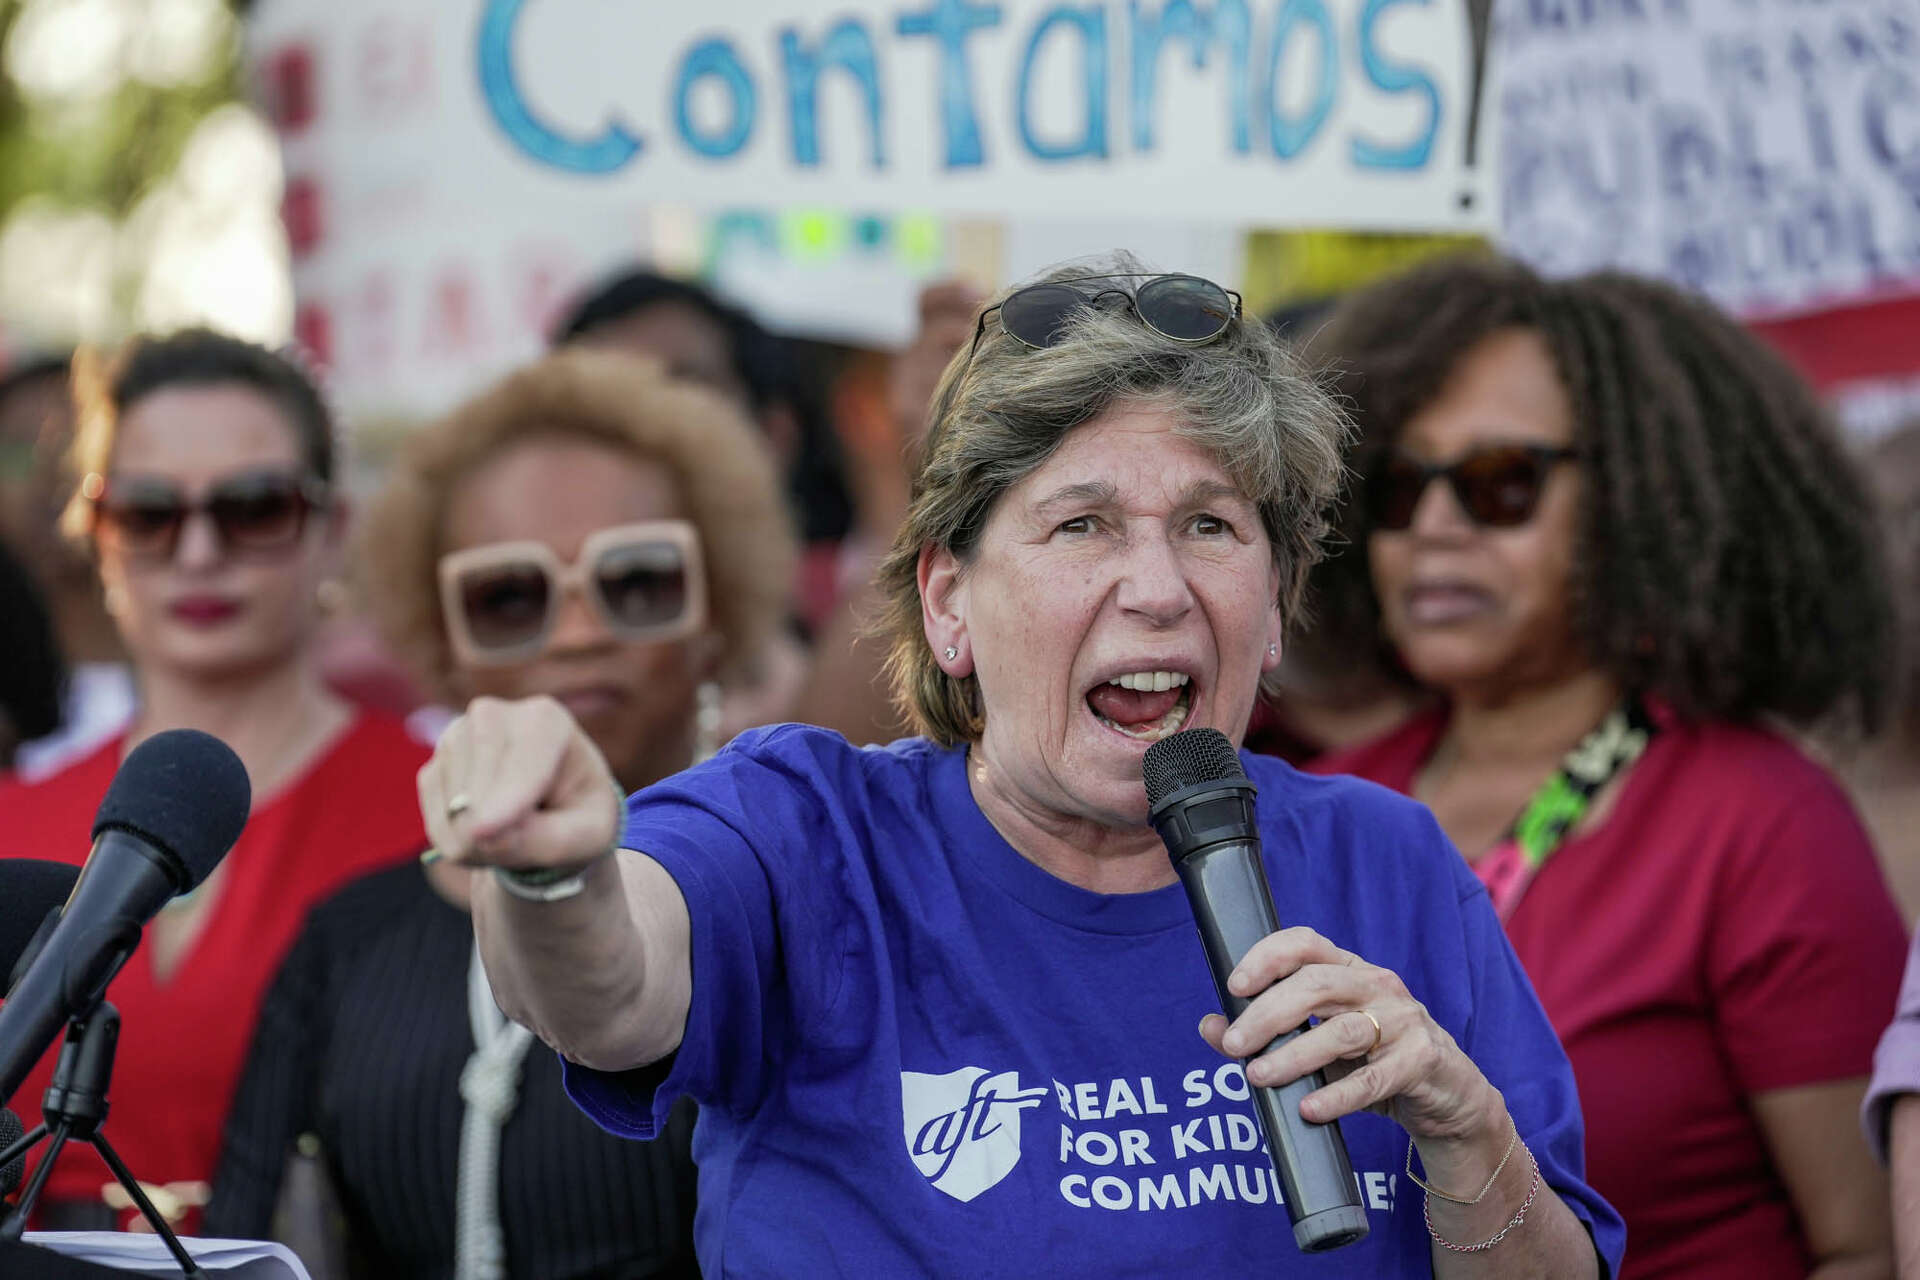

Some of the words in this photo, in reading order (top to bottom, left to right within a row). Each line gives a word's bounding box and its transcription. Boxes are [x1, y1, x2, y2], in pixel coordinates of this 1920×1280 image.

[1052, 1077, 1168, 1120] REAL
[1060, 1123, 1157, 1166] FOR
[1170, 1113, 1269, 1160] KID
